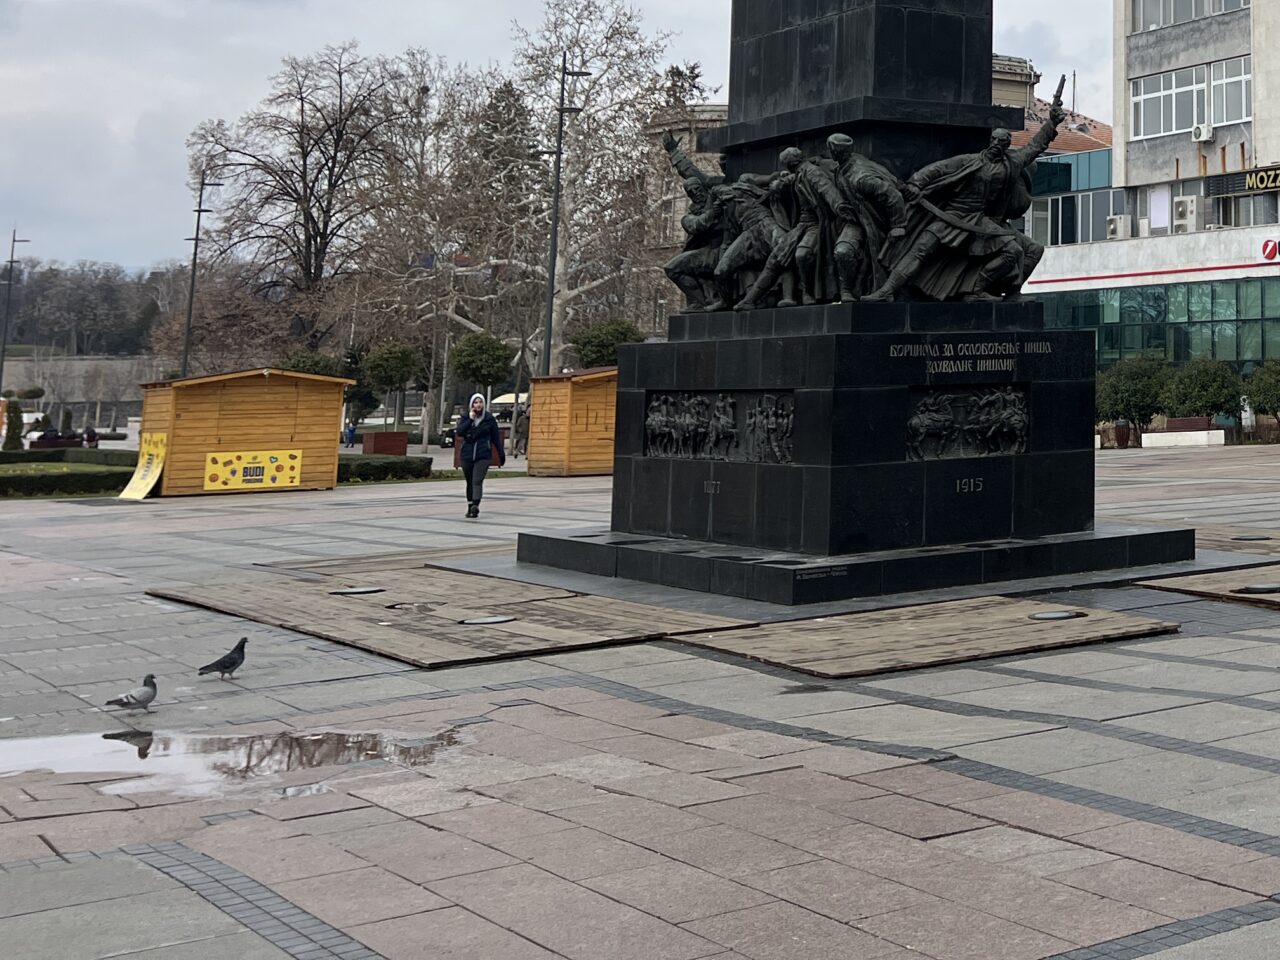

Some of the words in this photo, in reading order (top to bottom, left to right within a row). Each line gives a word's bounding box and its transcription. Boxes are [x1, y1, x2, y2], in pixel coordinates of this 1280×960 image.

[889, 343, 940, 357] БОРЦИМА
[942, 343, 954, 357] ЗА
[1024, 341, 1052, 355] НИША
[242, 465, 265, 477] BUDI
[956, 477, 984, 493] 1915
